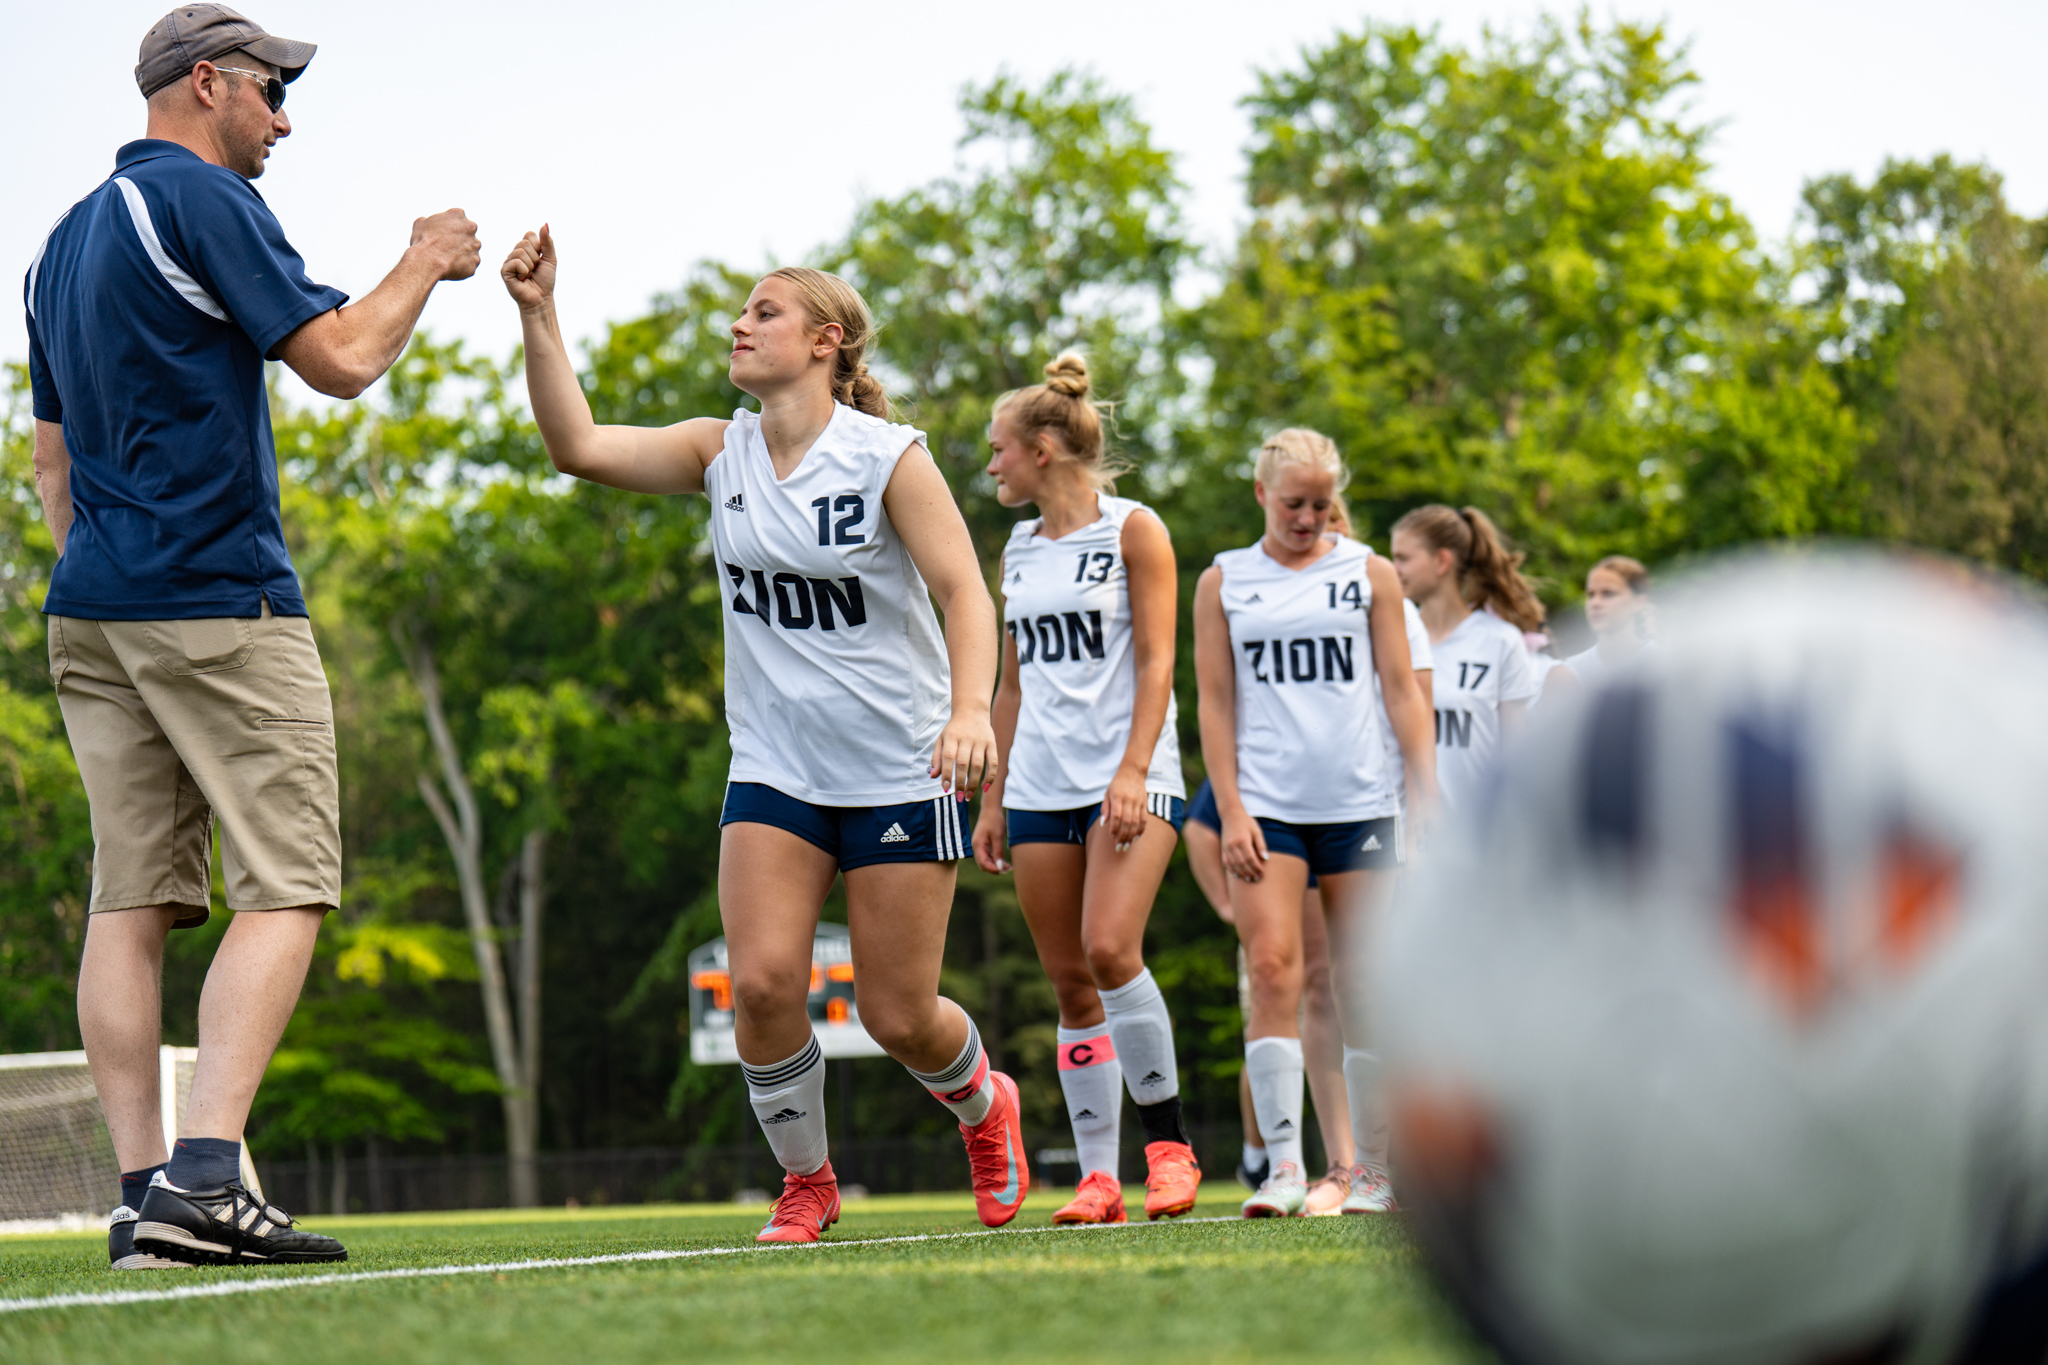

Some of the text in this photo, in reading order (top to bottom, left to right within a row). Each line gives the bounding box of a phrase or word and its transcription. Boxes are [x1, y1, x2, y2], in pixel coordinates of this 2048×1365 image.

[725, 502, 744, 512] adidas
[811, 494, 866, 546] 12
[1074, 551, 1114, 583] 13
[1325, 580, 1362, 610] 14
[1242, 636, 1354, 684] ZION
[1458, 661, 1490, 690] 17
[880, 834, 910, 844] adidas
[1068, 1044, 1094, 1066] C
